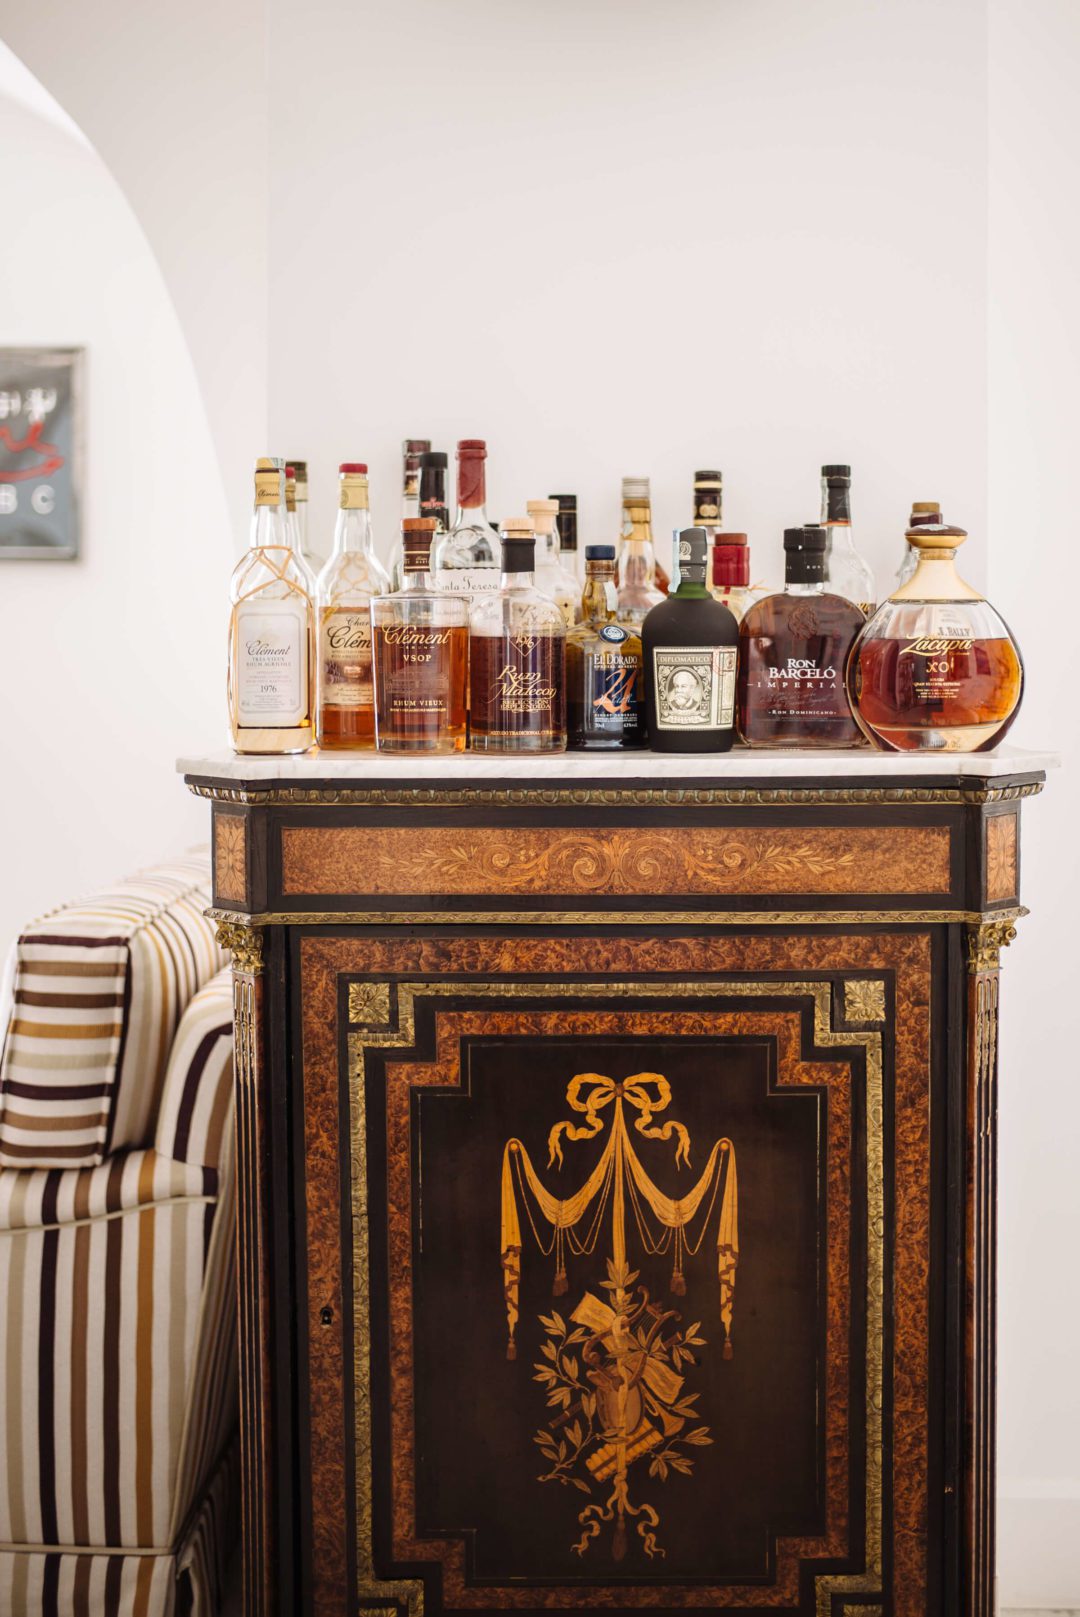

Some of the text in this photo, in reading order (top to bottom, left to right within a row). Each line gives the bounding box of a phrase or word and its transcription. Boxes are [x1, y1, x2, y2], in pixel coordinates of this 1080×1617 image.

[382, 621, 453, 645] Clément
[245, 640, 291, 656] Clément
[899, 633, 976, 657] Zacapa
[403, 654, 432, 662] VSOP
[593, 653, 638, 666] EL DORADO
[787, 658, 817, 669] RON
[496, 665, 542, 682] Rum
[768, 665, 836, 680] BARCELÓ
[260, 685, 278, 693] 1976
[757, 681, 847, 689] IMPERIAL
